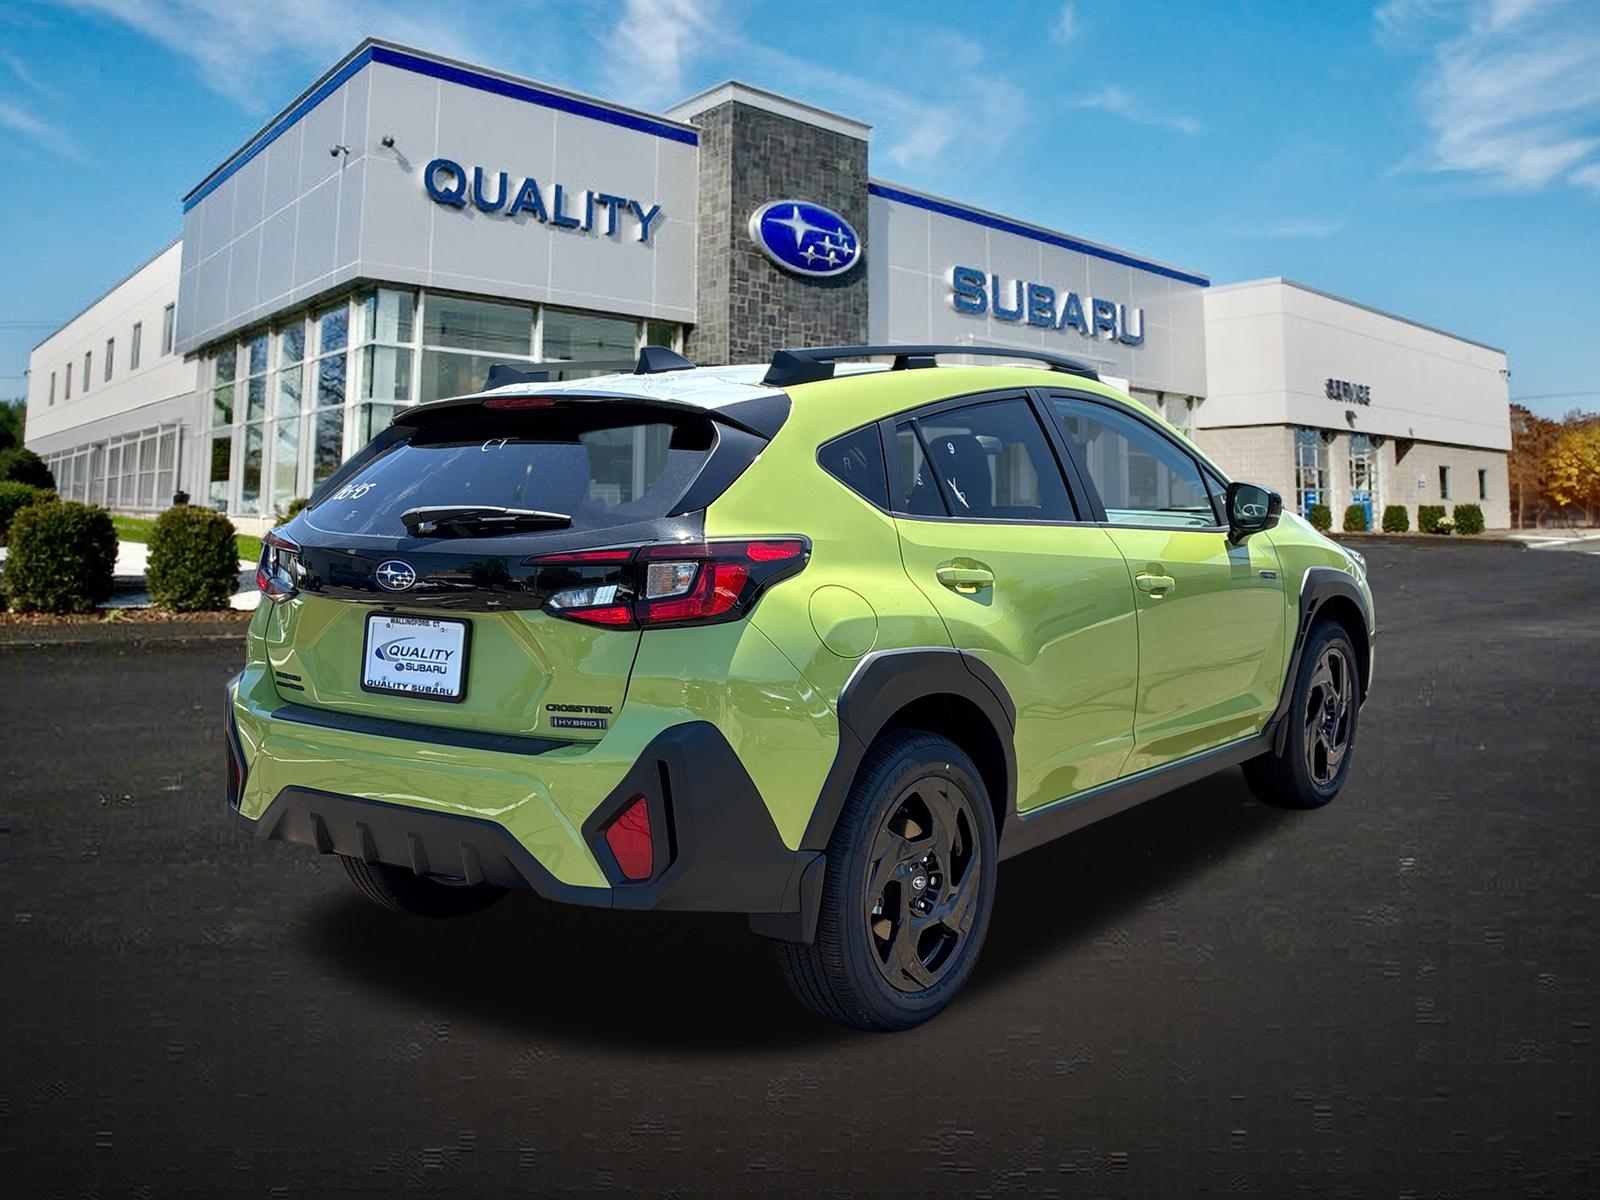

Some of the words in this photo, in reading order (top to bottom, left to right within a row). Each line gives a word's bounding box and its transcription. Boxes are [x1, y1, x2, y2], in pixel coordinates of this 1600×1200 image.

[424, 157, 661, 243] QUALITY
[950, 265, 1145, 346] SUBARU
[389, 645, 454, 660] QUALITY
[405, 662, 447, 674] SUBARU
[367, 679, 409, 690] QUALITY
[411, 684, 453, 696] SUBARU
[545, 704, 613, 715] CROSSTREK
[558, 719, 597, 727] HYBRID
